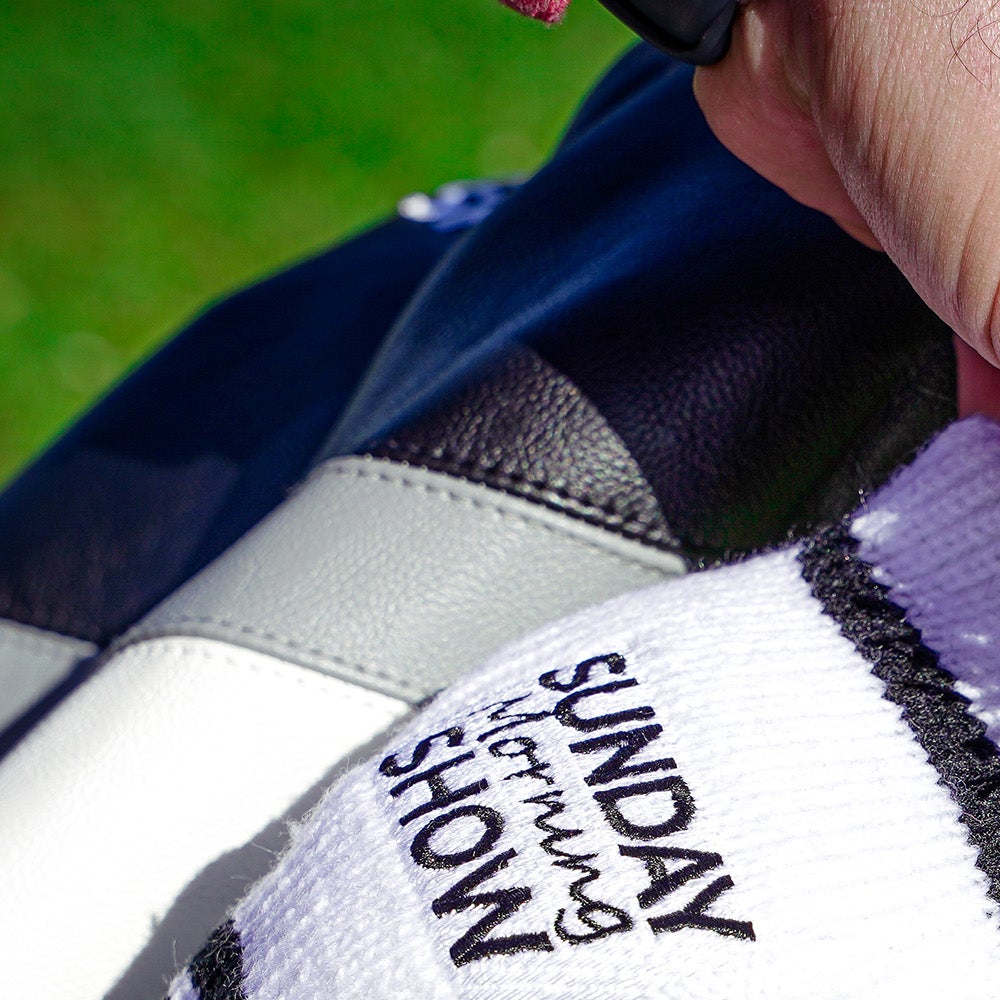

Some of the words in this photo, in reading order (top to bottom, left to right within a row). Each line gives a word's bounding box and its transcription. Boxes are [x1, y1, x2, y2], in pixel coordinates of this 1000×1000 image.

[379, 726, 555, 968] SHOW
[467, 693, 634, 945] Morning
[538, 652, 756, 941] SUNDAY
